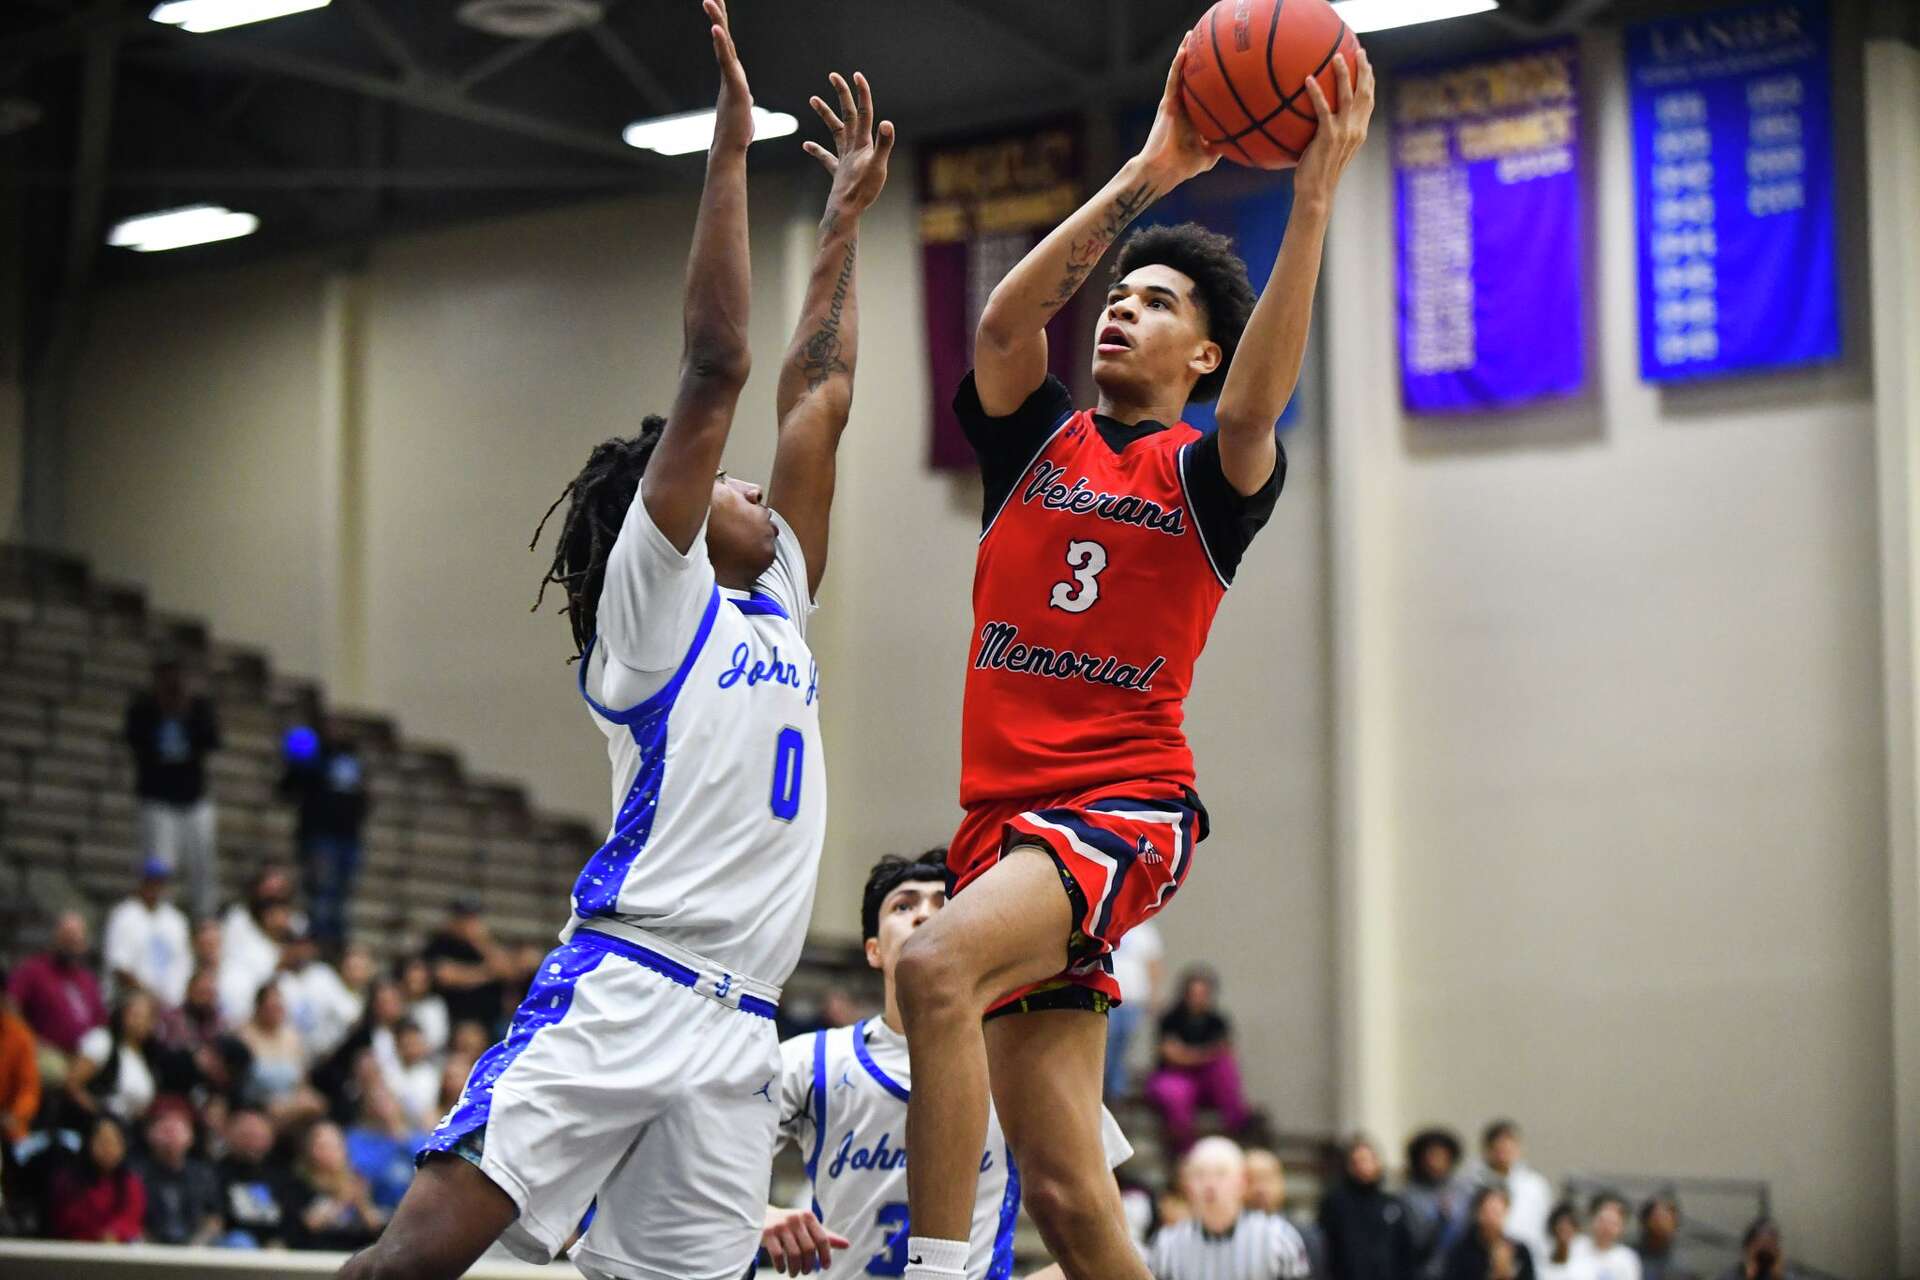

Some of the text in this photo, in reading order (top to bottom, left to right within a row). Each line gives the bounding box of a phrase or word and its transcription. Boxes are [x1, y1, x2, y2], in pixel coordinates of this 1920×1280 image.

[1022, 460, 1187, 537] Veterans
[1048, 538, 1109, 613] 3
[718, 642, 800, 690] John
[974, 621, 1167, 693] Memorial
[770, 725, 805, 823] 0
[828, 1130, 907, 1180] John
